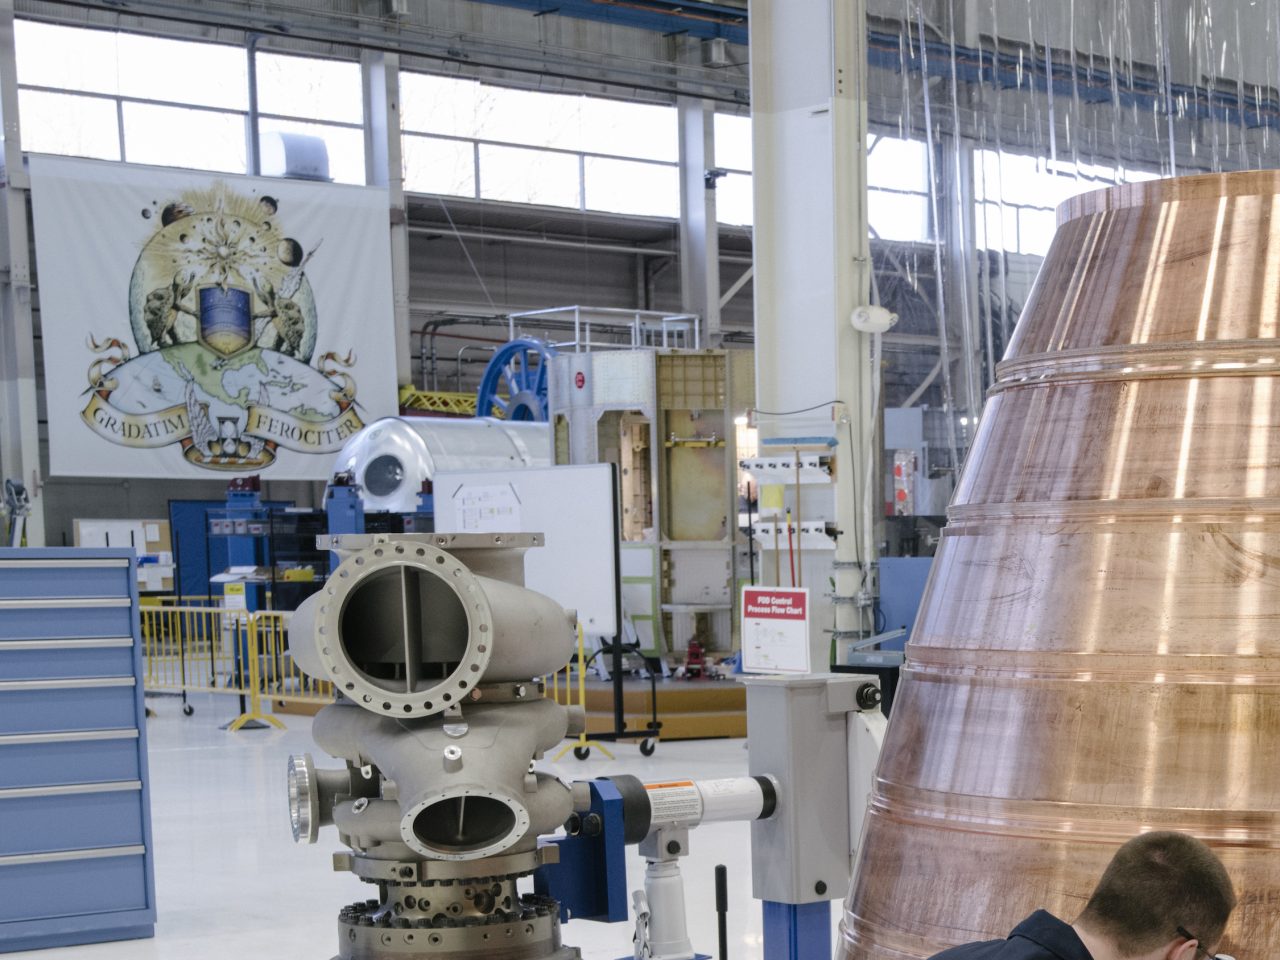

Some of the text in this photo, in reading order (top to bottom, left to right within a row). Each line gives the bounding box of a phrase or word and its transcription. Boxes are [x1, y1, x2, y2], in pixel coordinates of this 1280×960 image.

[92, 407, 360, 446] GRADATIM FEROCITER
[771, 597, 793, 605] Control
[747, 605, 802, 615] Process Flow Chart
